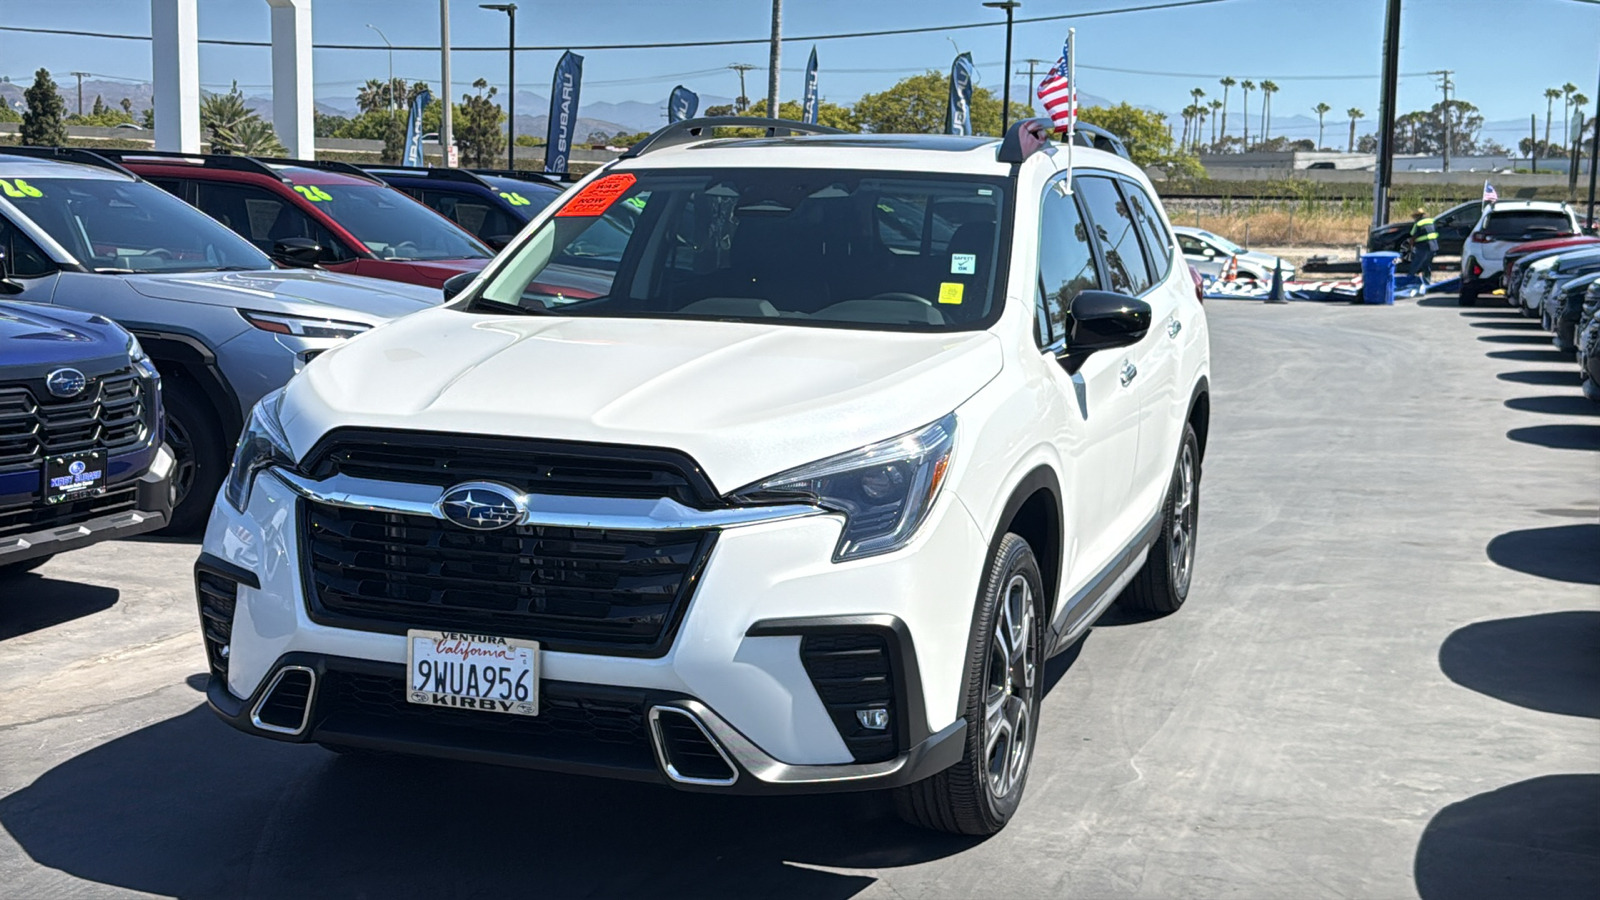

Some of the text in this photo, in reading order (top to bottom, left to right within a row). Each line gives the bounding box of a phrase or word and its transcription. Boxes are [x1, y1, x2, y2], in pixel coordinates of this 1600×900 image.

[557, 73, 574, 152] SUBARU
[0, 179, 43, 197] 26
[293, 185, 333, 201] 26
[499, 192, 531, 206] 26
[441, 632, 508, 646] VENTURA
[436, 639, 515, 661] California
[418, 659, 530, 702] 9WUA956
[432, 693, 515, 712] KIRBY
